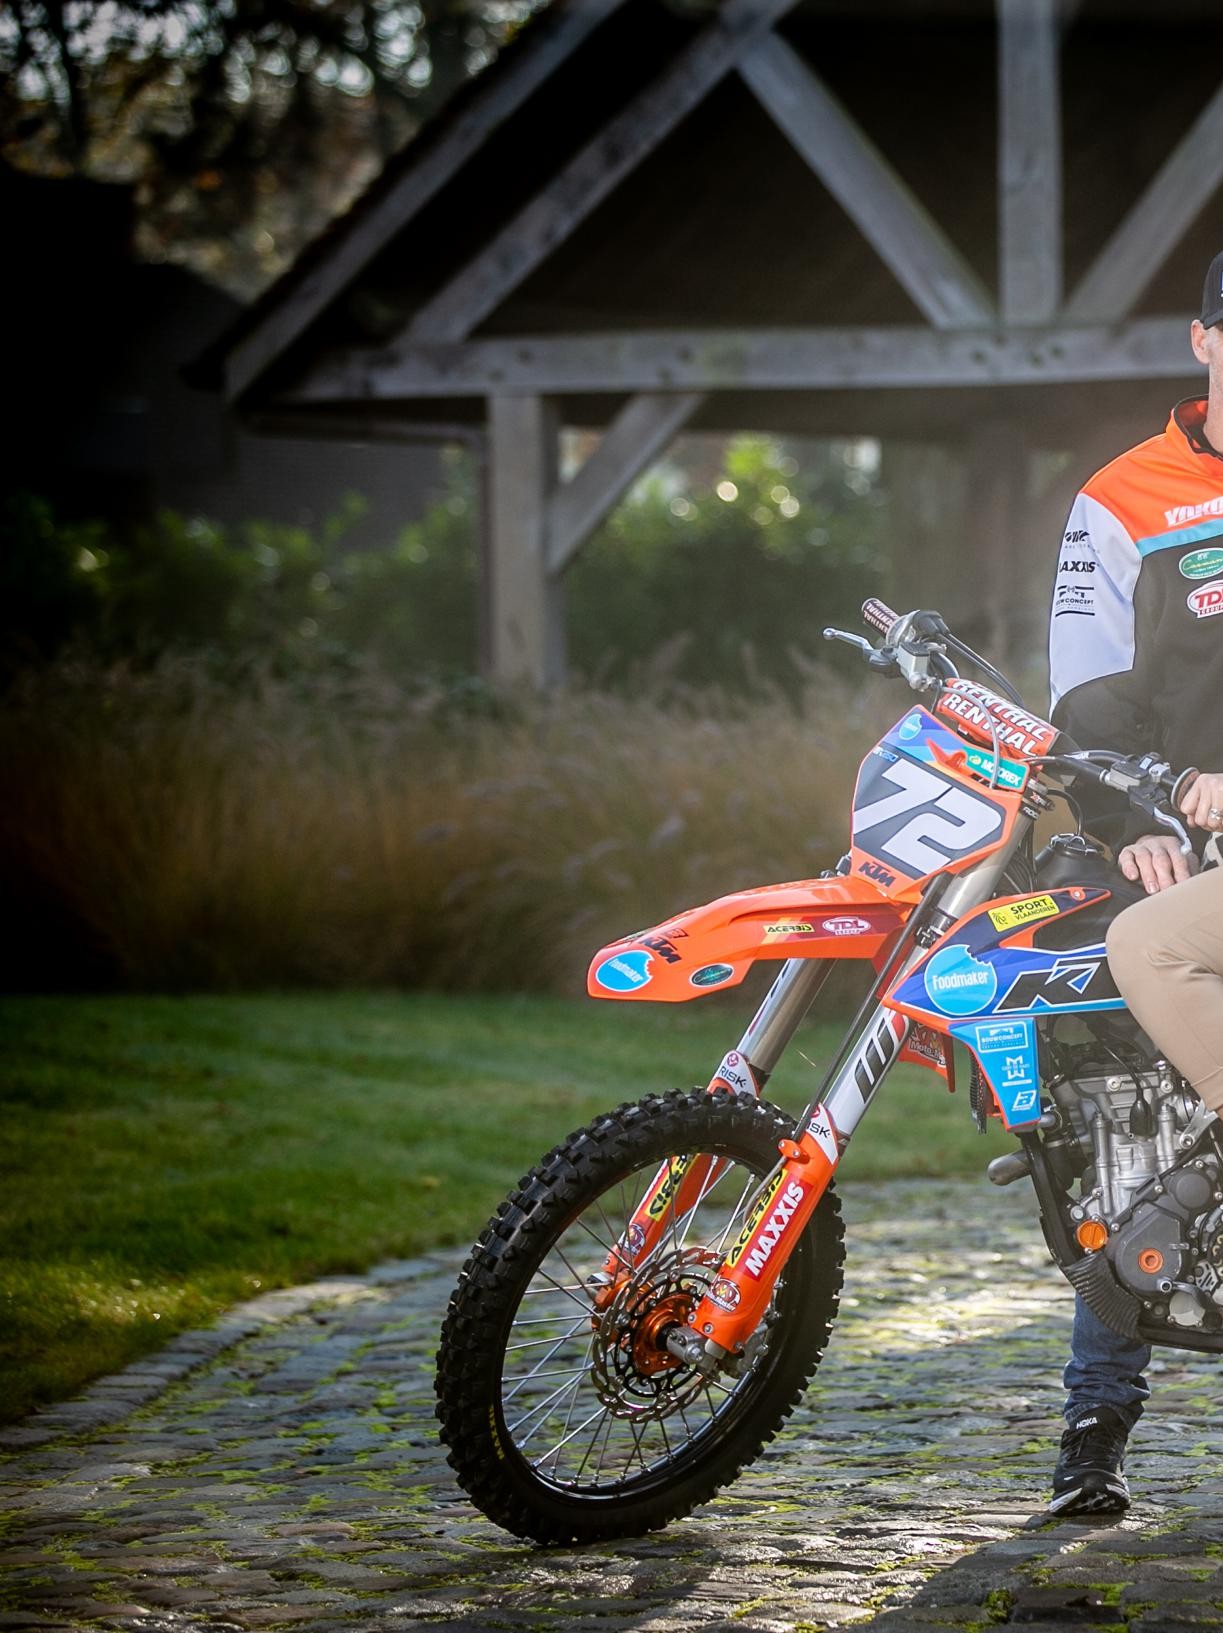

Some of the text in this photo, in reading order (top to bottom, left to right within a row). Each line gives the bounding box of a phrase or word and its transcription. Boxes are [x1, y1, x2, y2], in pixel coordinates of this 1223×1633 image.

[1059, 560, 1097, 574] AXXIS
[952, 680, 1049, 741] RENTHAL
[942, 693, 1037, 757] RENTHAL
[853, 757, 1002, 876] 72
[858, 861, 896, 888] KTM
[829, 920, 865, 930] TDL
[1014, 904, 1057, 921] VLAANDEREN
[640, 936, 683, 965] KTM
[931, 970, 989, 992] Foodmaker
[718, 1065, 746, 1088] RISK
[806, 1122, 832, 1138] ISK
[730, 1170, 784, 1265] ACERBIS
[744, 1181, 805, 1277] MAXXIS
[1076, 1416, 1098, 1430] HOKA
